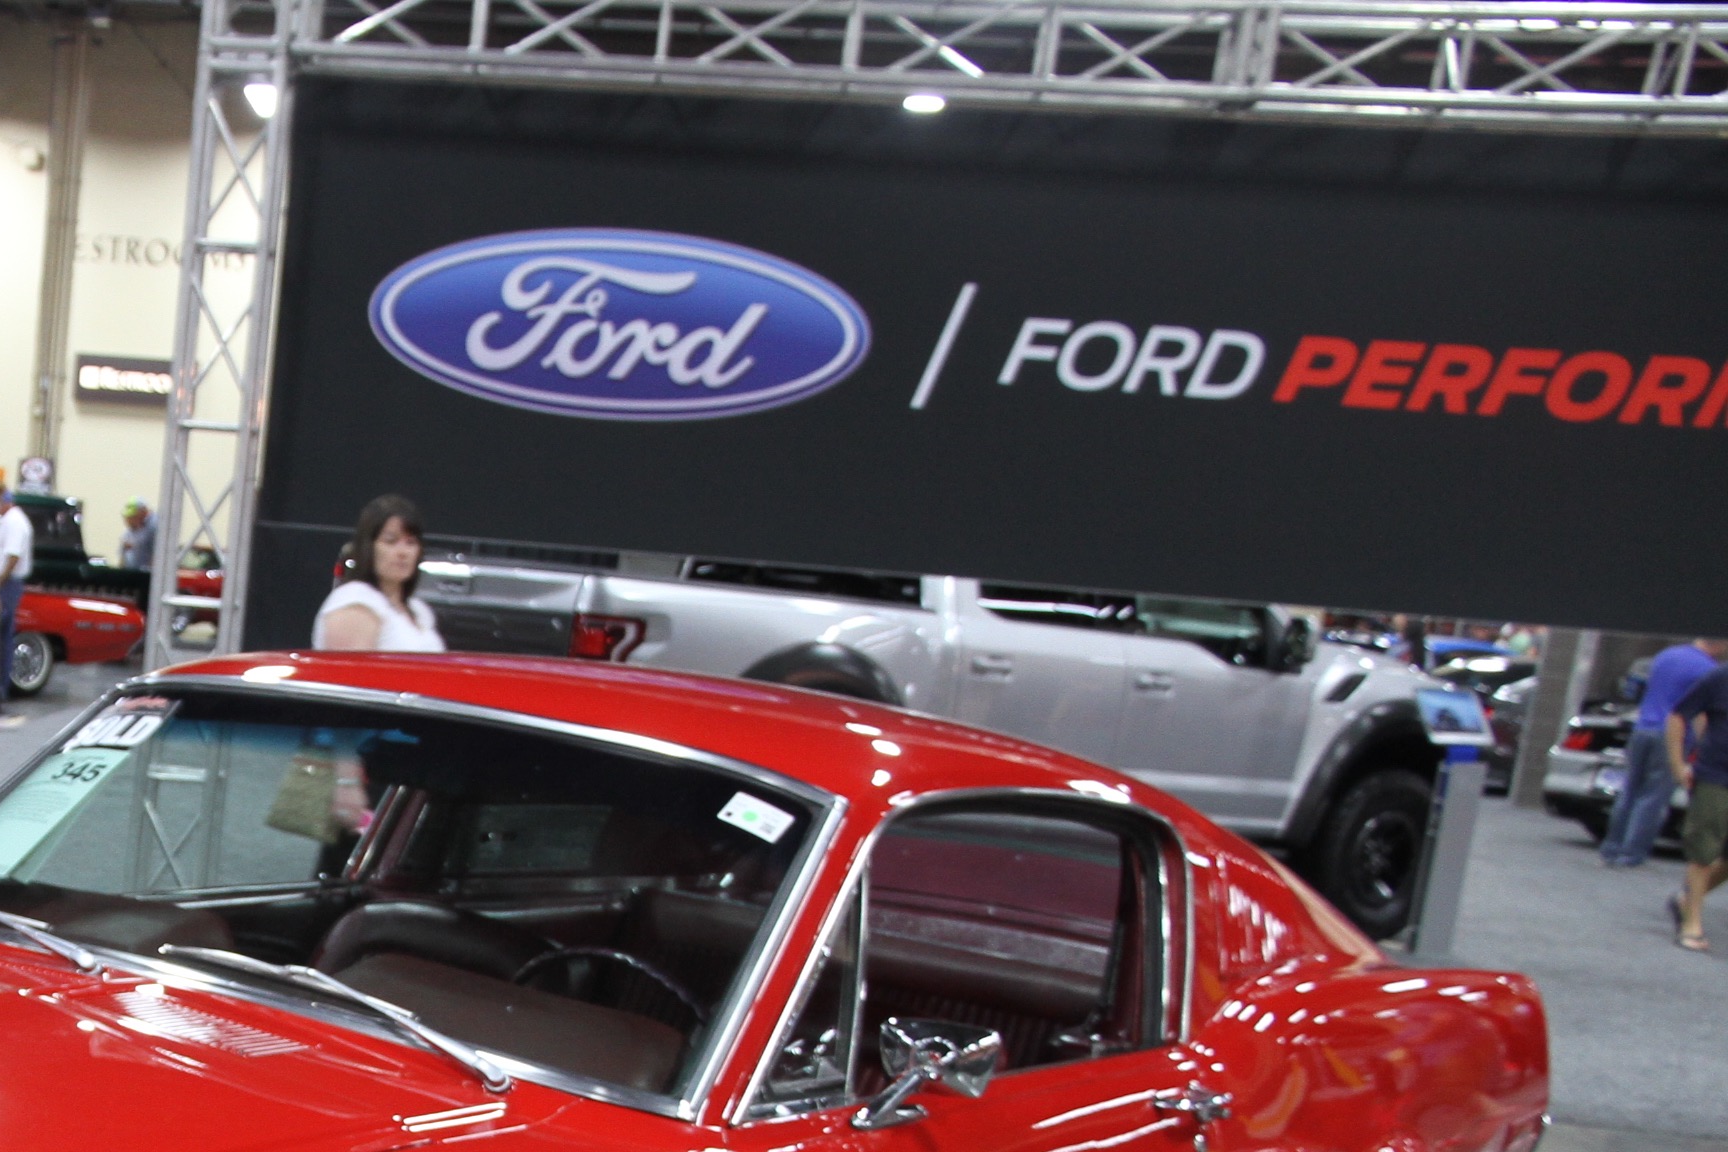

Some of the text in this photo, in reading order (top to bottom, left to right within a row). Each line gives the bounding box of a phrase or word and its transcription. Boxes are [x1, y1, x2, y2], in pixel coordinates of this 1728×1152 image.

[465, 257, 769, 388] Ford
[998, 317, 1728, 428] FORD PERFOR
[51, 761, 108, 782] 345
